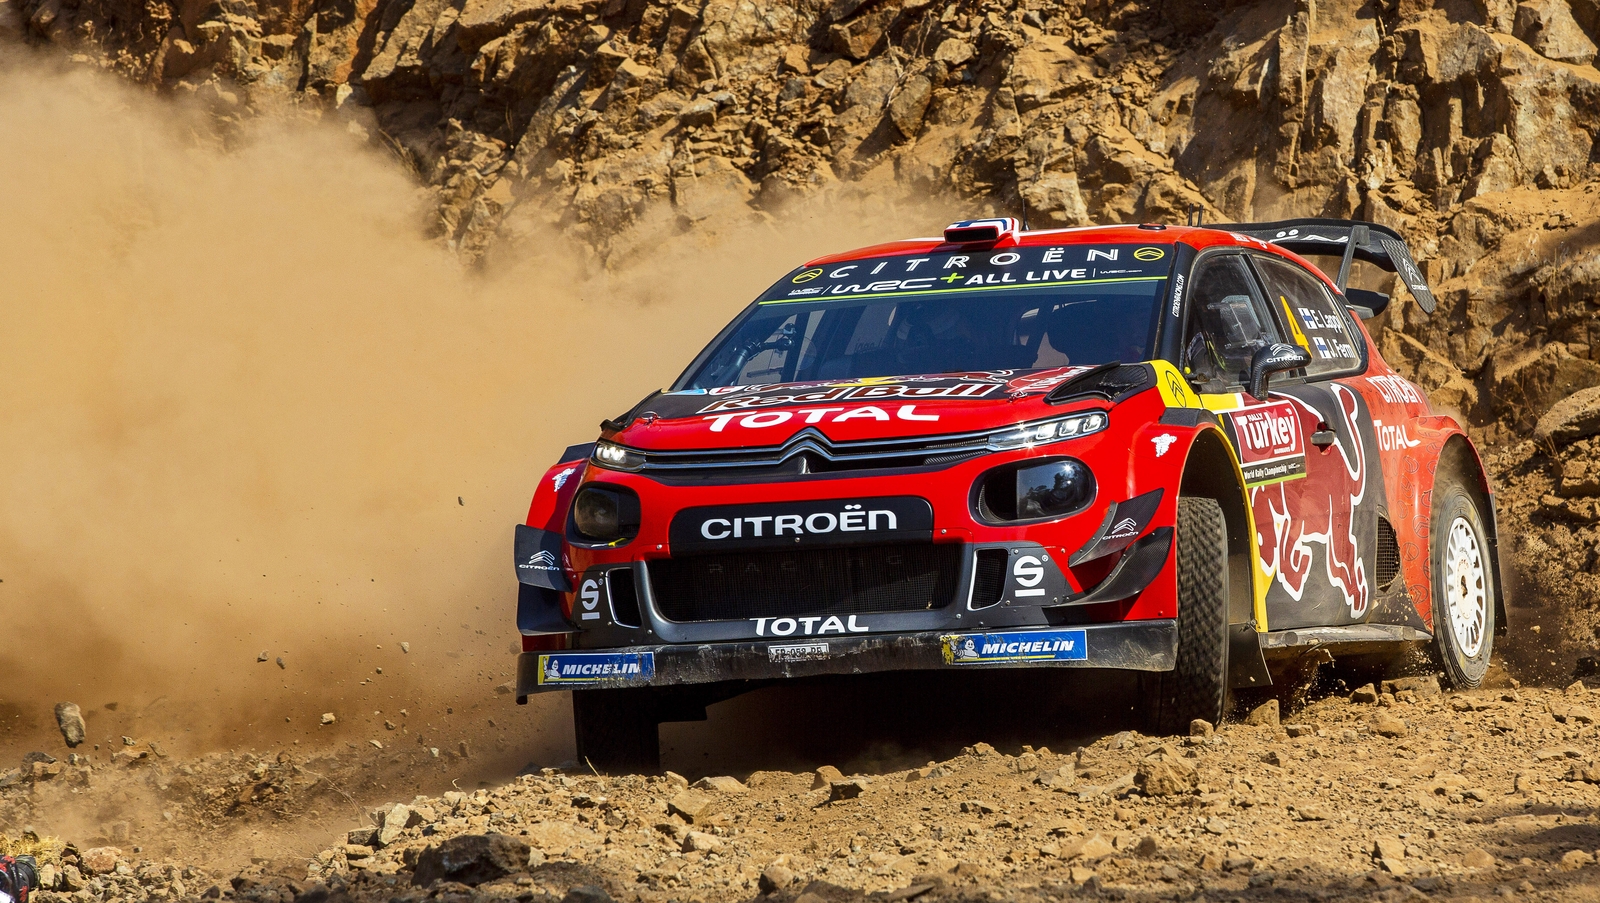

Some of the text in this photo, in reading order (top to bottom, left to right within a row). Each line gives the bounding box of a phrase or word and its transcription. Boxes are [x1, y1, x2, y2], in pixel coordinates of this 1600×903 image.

[829, 247, 1119, 279] CITROËN
[964, 272, 1017, 286] ALL
[1025, 268, 1087, 282] LIVE
[1280, 295, 1313, 359] 4
[842, 383, 1004, 400] Bull
[702, 404, 940, 432] TOTAL
[1235, 408, 1297, 452] Turkey
[1373, 419, 1422, 451] TOTAL
[700, 504, 898, 540] CITROËN
[749, 614, 869, 636] TOTAL
[981, 639, 1075, 655] MICHELIN
[562, 663, 641, 675] MICHELIN
